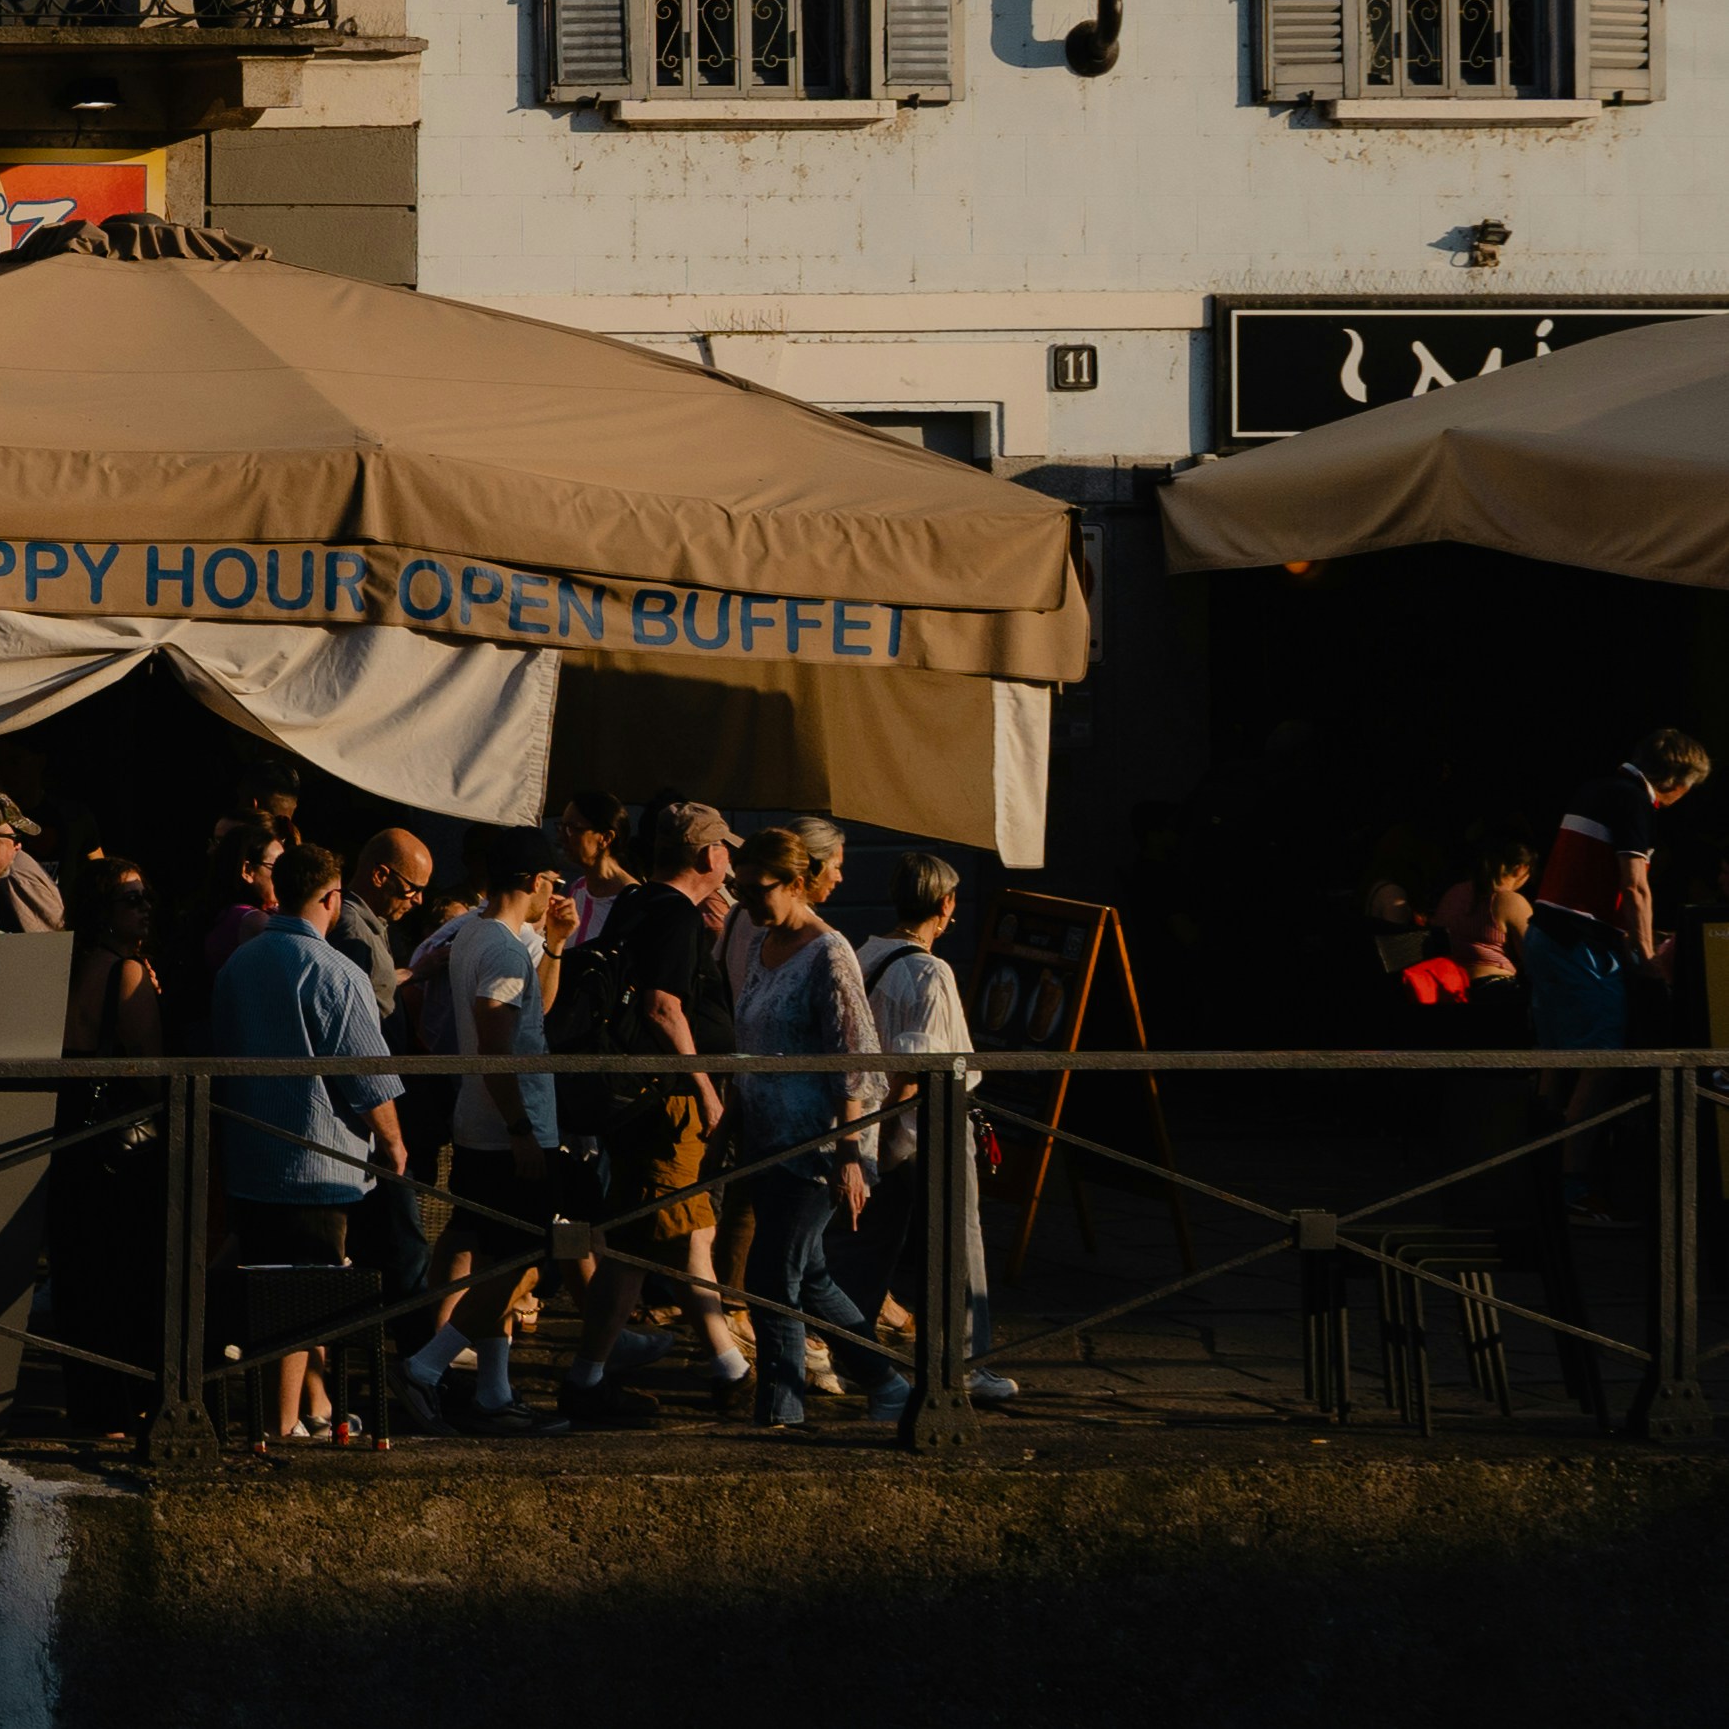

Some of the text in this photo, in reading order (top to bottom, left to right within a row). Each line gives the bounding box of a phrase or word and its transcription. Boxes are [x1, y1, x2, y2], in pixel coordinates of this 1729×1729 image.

[1064, 351, 1090, 383] 11
[145, 544, 369, 613] HOUR
[398, 559, 607, 641] OPEN
[630, 588, 904, 658] BUFFET
